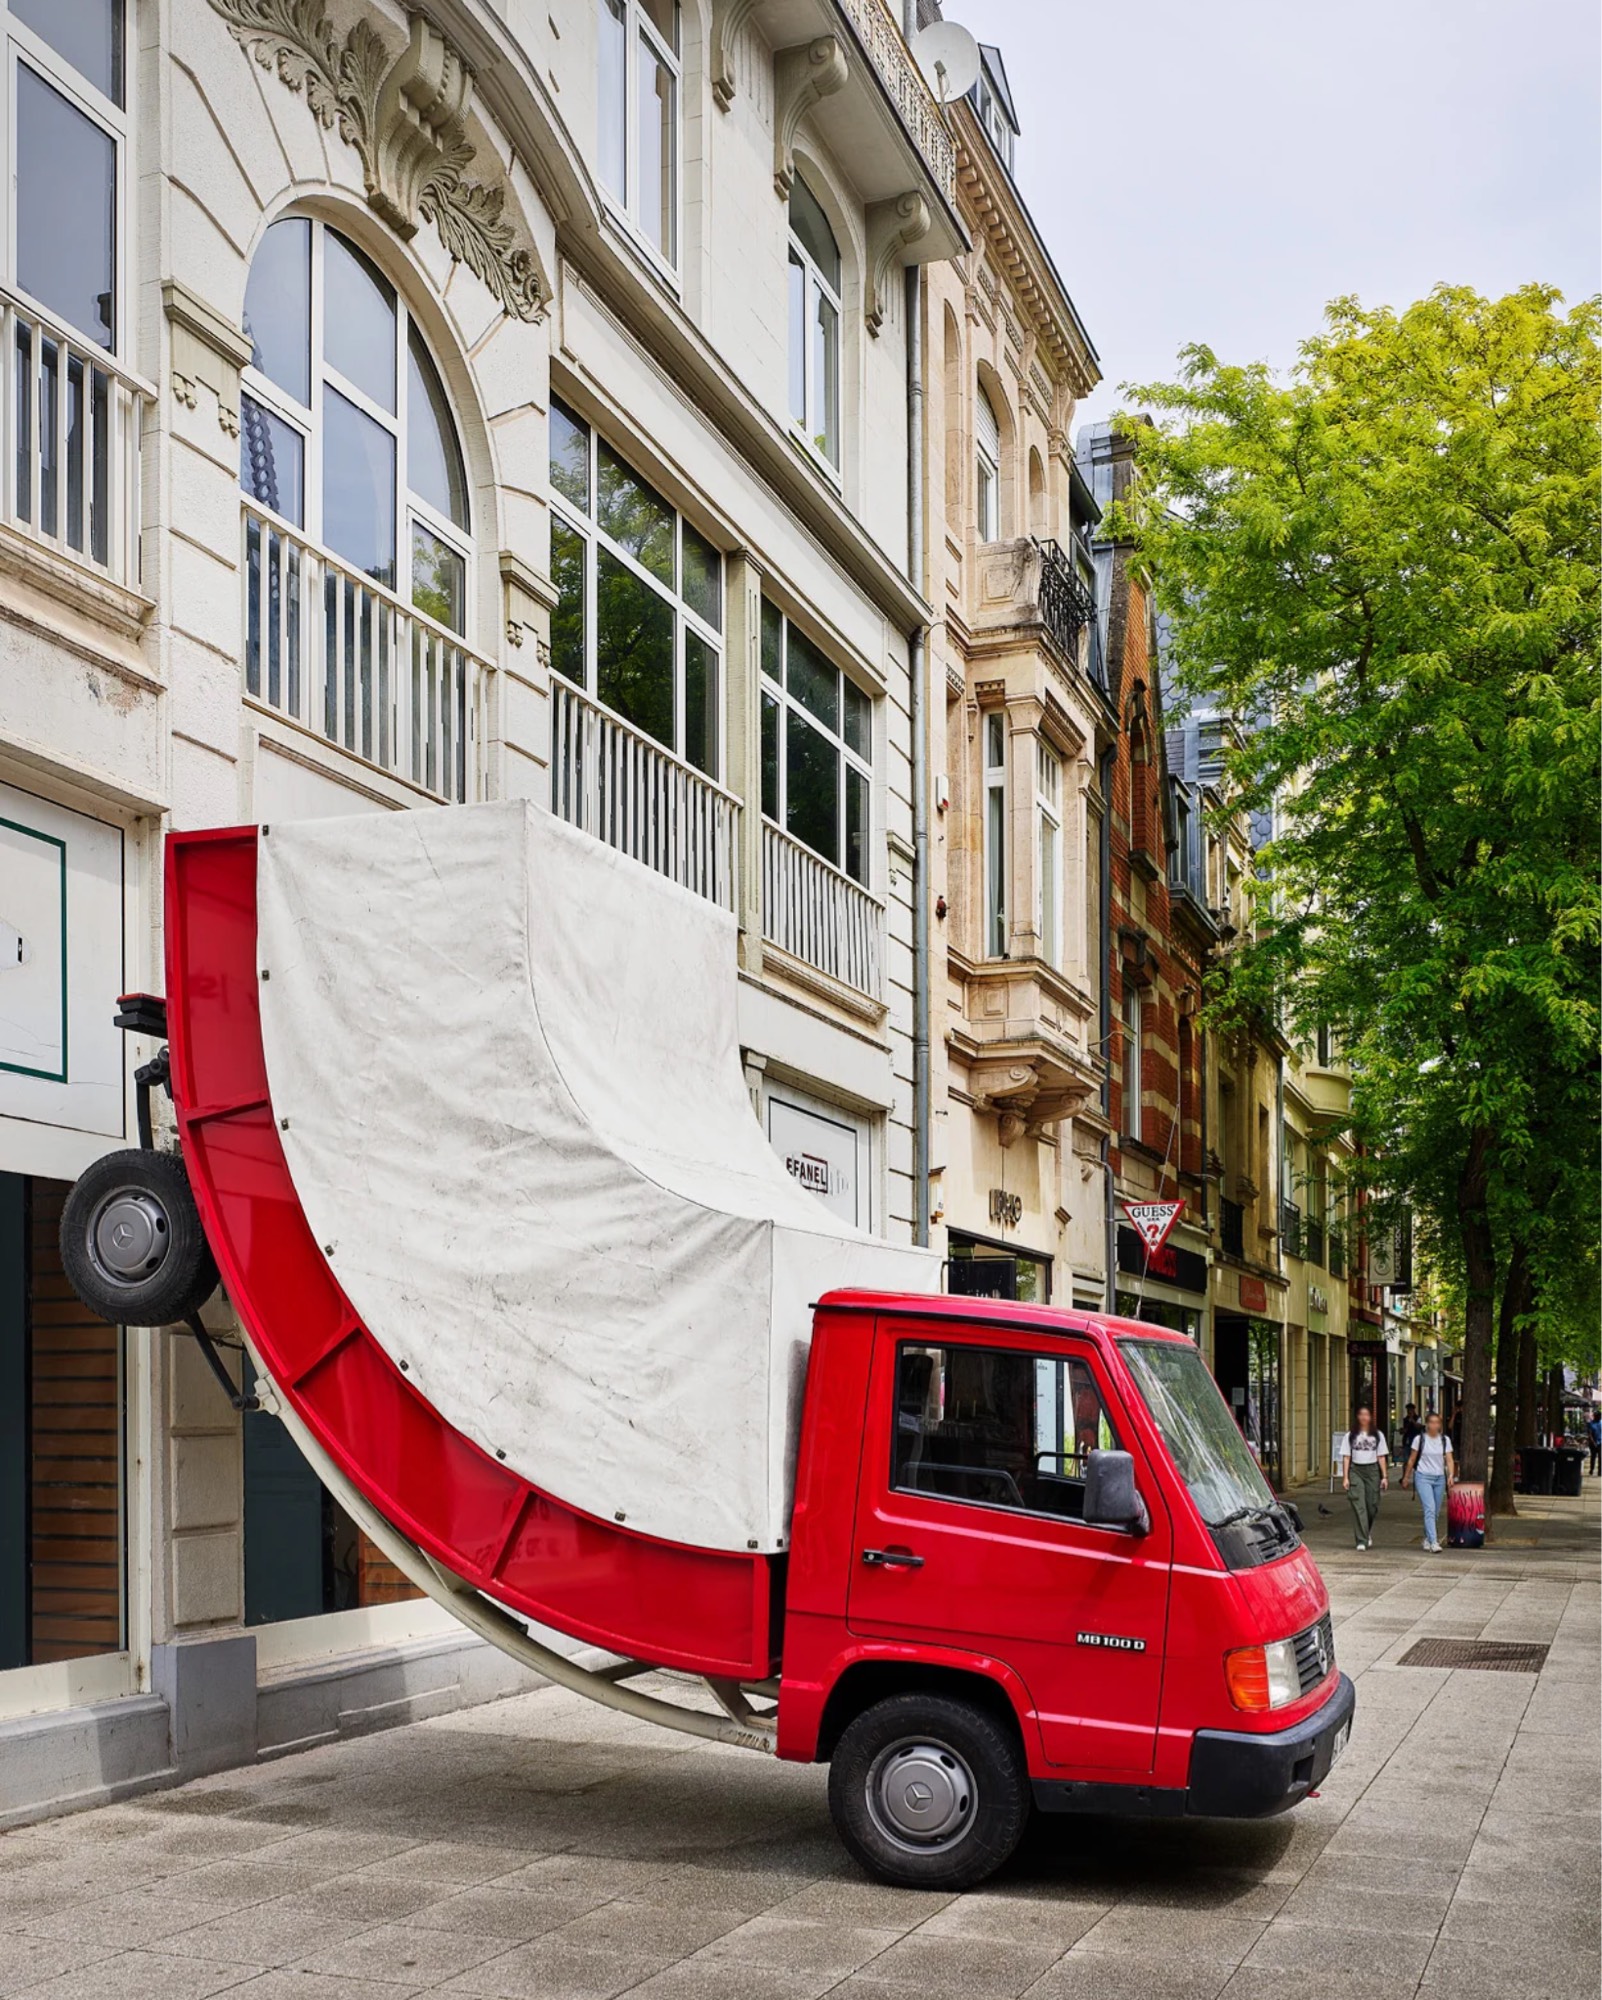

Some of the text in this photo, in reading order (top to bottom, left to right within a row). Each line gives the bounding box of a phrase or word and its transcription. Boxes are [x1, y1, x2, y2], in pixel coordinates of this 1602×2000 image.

[1132, 1206, 1173, 1218] GUESS
[1077, 1633, 1145, 1650] MB 100 D
